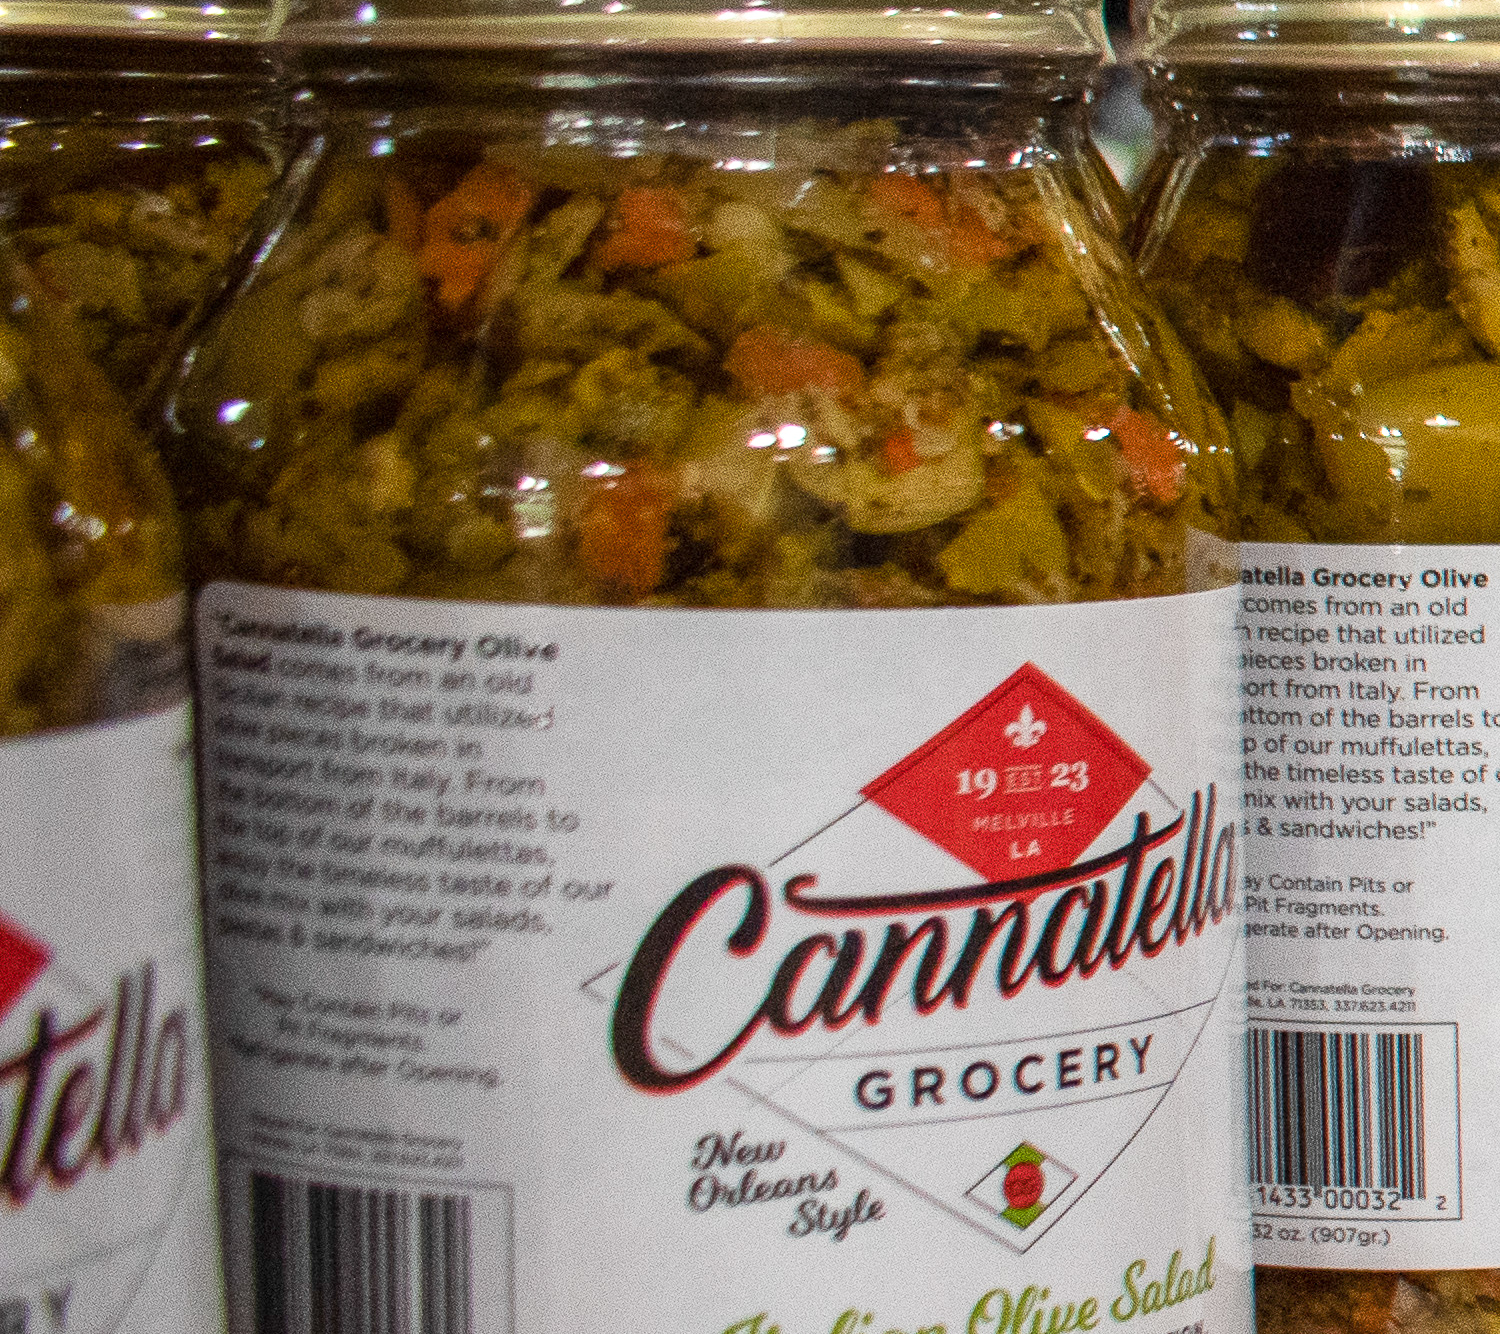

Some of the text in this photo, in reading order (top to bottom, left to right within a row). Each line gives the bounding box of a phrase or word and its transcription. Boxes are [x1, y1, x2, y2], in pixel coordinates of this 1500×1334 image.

[1241, 567, 1490, 593] atella Grocery Olive
[1242, 595, 1469, 618] comes from an old
[475, 631, 559, 664] Olive
[1256, 622, 1487, 648] recipe that utilized
[1312, 651, 1398, 673] broken
[1405, 653, 1428, 674] in
[1285, 678, 1341, 701] from
[1413, 680, 1481, 703] From
[1241, 706, 1302, 728] ttom
[1309, 706, 1336, 729] of
[1340, 707, 1382, 729] the
[1387, 708, 1476, 731] barrels
[1264, 733, 1490, 761] of our muffulettas,
[955, 765, 998, 800] 19
[1050, 759, 1091, 792] 23
[1286, 763, 1386, 786] timeless
[1392, 766, 1456, 786] taste
[1461, 765, 1488, 786] of
[1282, 790, 1335, 813] with
[1340, 795, 1397, 816] your
[1403, 793, 1488, 815] salads,
[972, 805, 1077, 835] MELVILLE
[1256, 816, 1278, 838] &
[1009, 837, 1042, 862] LA
[1268, 874, 1345, 894] Contain
[1348, 875, 1388, 895] Pits
[1392, 879, 1416, 895] or
[1245, 895, 1271, 915] Pit
[608, 781, 1237, 1097] Cannatella
[1303, 921, 1352, 941] after
[1357, 922, 1450, 944] Opening.
[1361, 983, 1416, 999] Grocery
[854, 1032, 1156, 1112] GROCERY
[690, 1130, 787, 1172] New
[686, 1165, 840, 1214] Orleans
[787, 1187, 886, 1242] Style
[1435, 1194, 1449, 1212] 2
[1109, 1235, 1219, 1323] Salad
